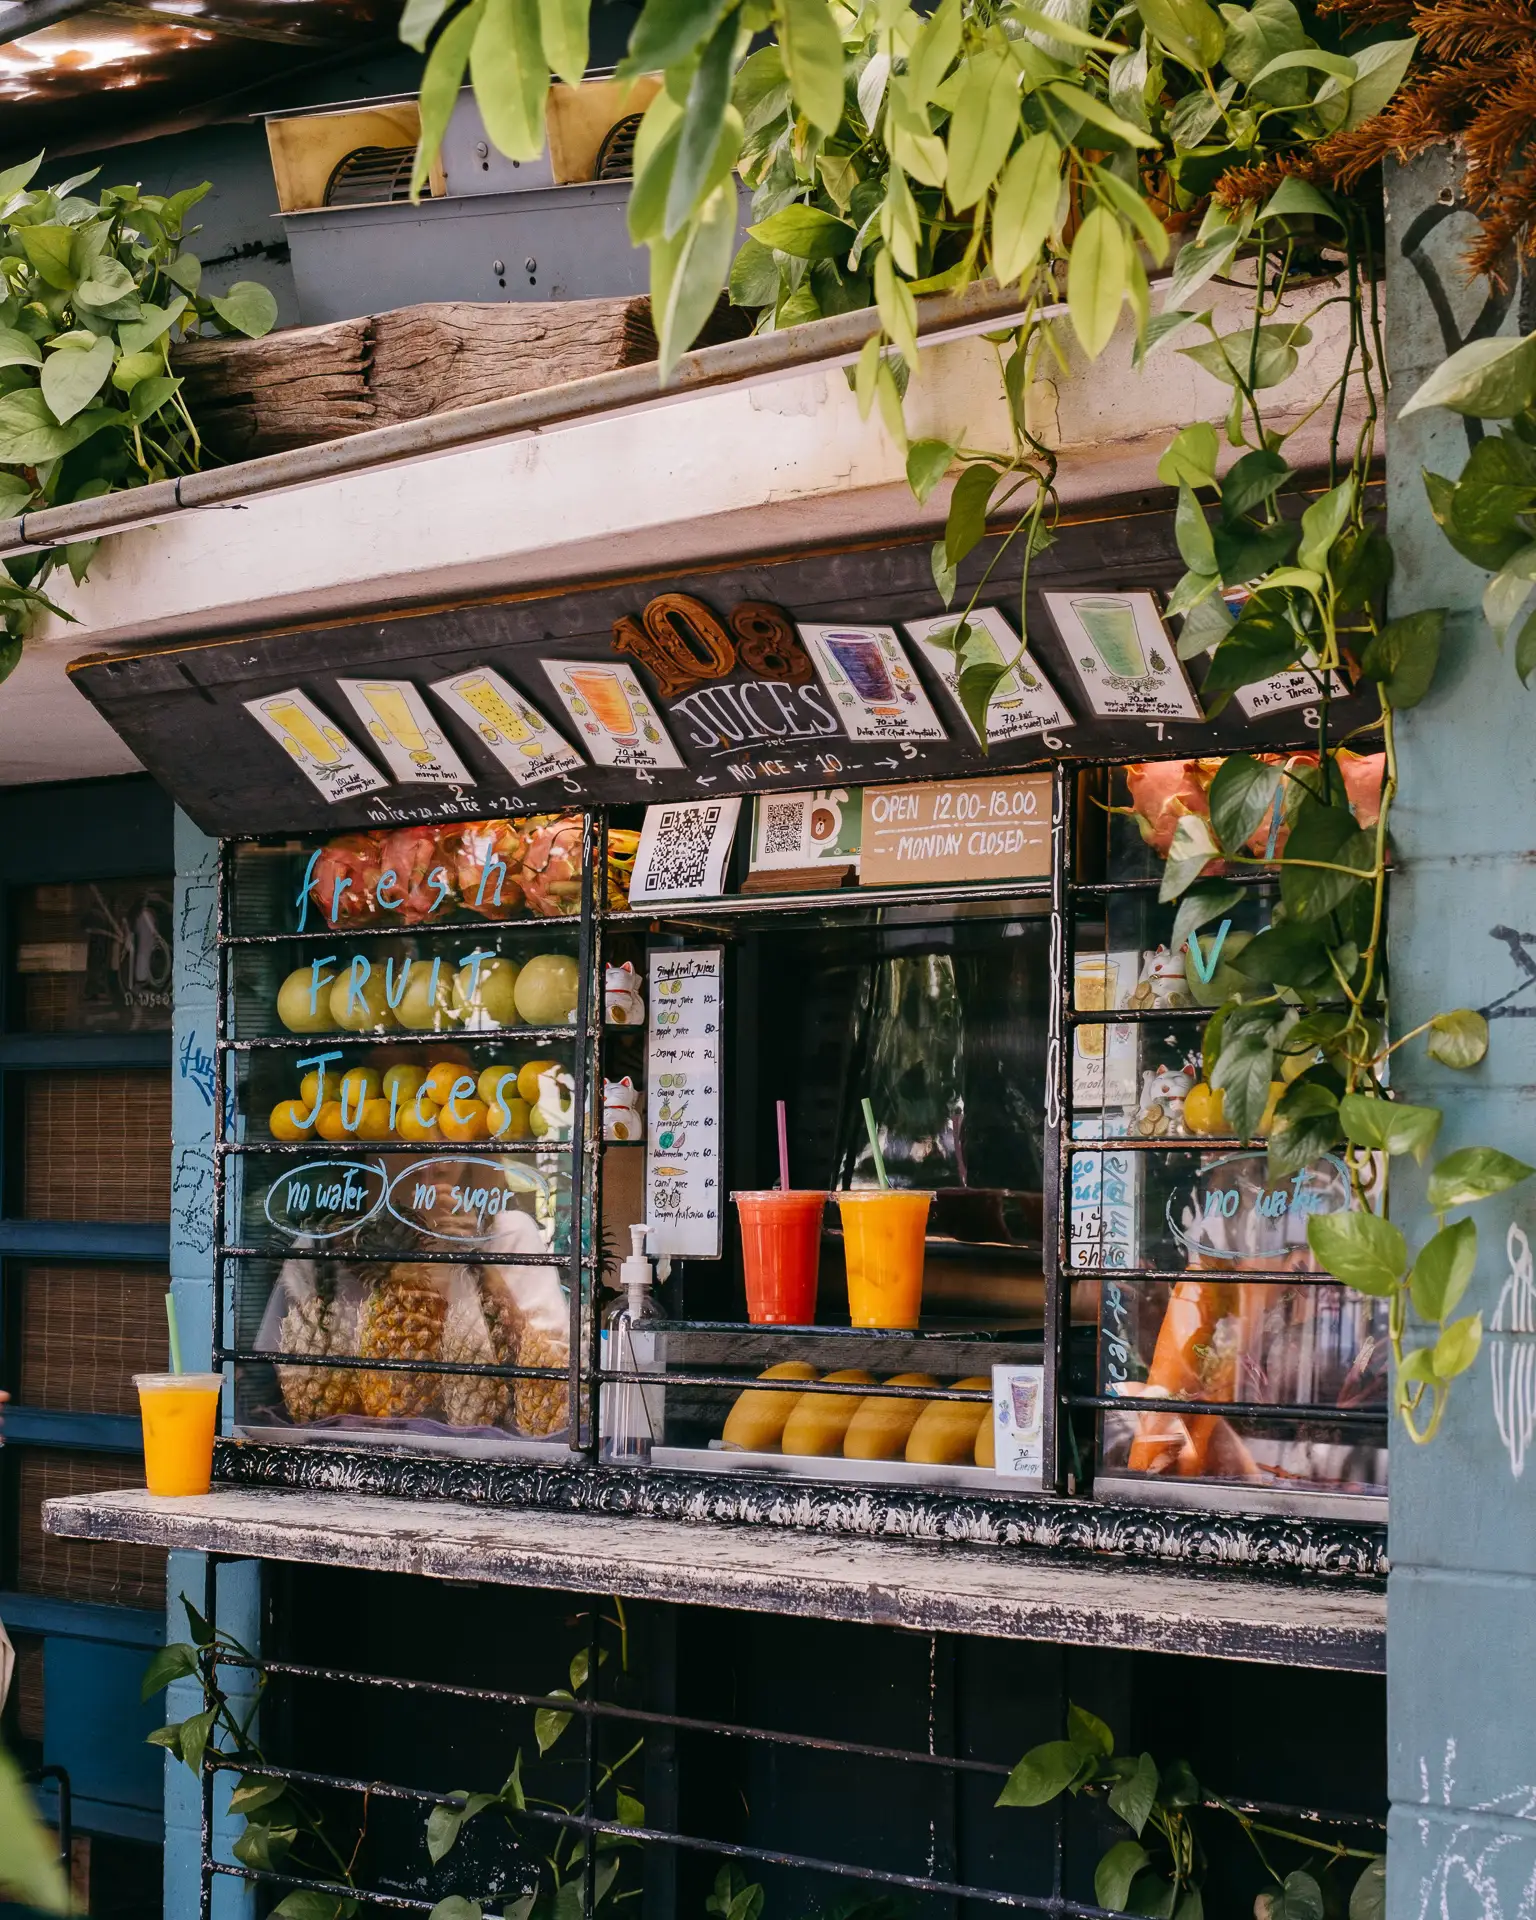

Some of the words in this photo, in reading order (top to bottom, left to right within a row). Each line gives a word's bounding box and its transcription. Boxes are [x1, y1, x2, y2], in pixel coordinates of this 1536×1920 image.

[610, 592, 813, 698] 108
[1286, 687, 1315, 699] Three
[670, 680, 838, 748] JUICES
[1042, 731, 1072, 750] 6.
[1144, 722, 1173, 741] 7.
[899, 741, 927, 760] 5.
[557, 773, 588, 793] 3.
[635, 767, 664, 785] 4.
[727, 763, 757, 782] NO
[758, 759, 791, 777] ICE
[448, 784, 475, 802] 2.
[872, 793, 919, 823] OPEN
[897, 829, 961, 861] MONDAY
[968, 826, 1025, 855] CLOSED
[296, 844, 507, 932] fresh
[309, 950, 497, 1016] FRUIT
[124, 990, 173, 1008] ถ.พระอ
[289, 1051, 519, 1136] Juices
[286, 1180, 309, 1214] no
[315, 1168, 370, 1213] water
[1204, 1189, 1239, 1218] no
[412, 1181, 437, 1212] no
[451, 1181, 513, 1236] sugar
[1013, 1459, 1040, 1476] Energy
